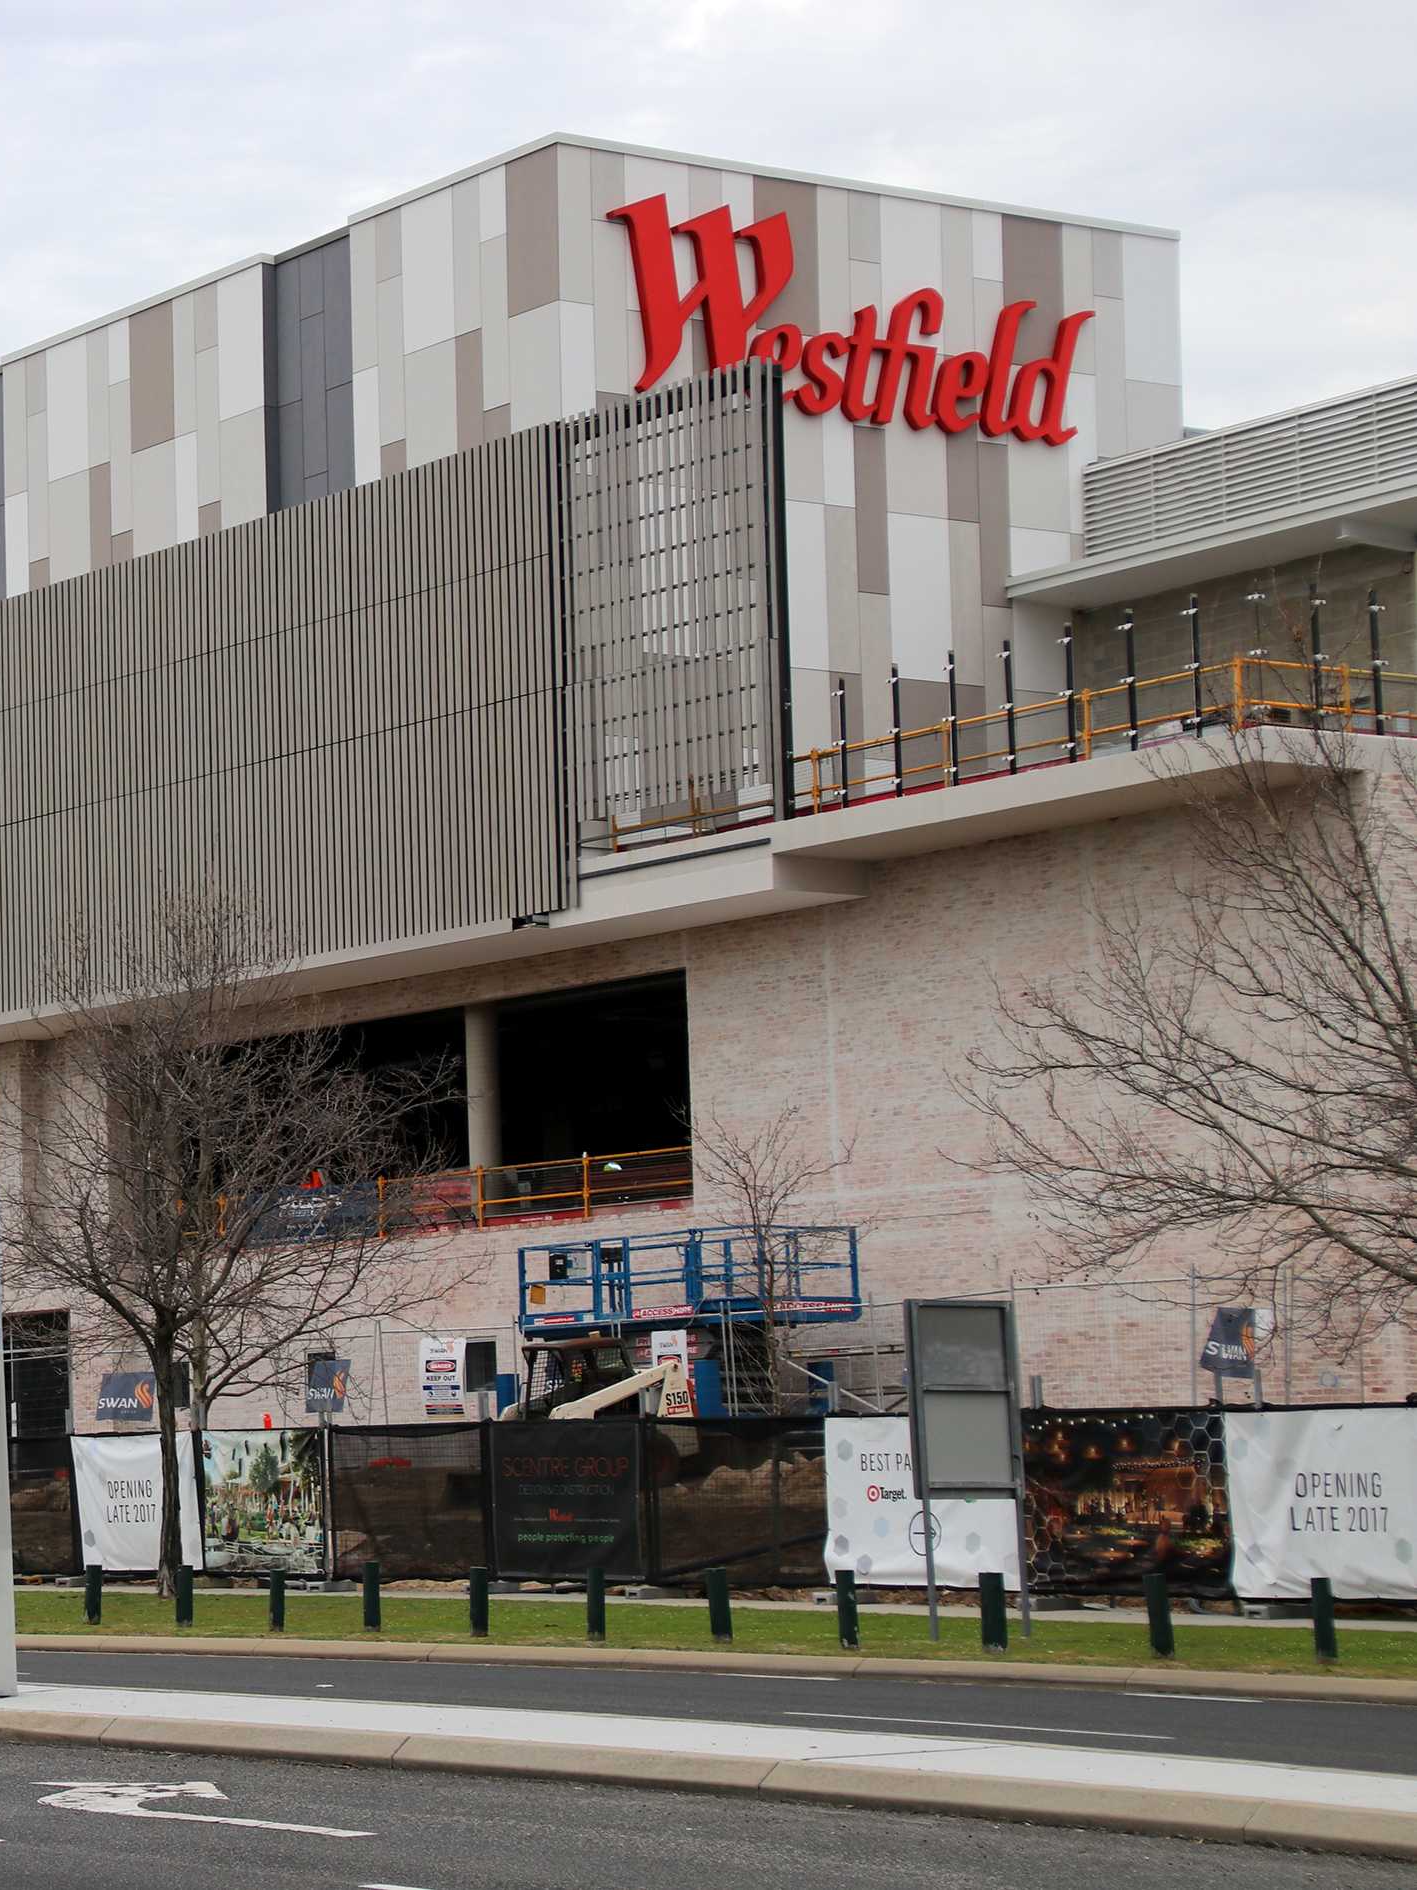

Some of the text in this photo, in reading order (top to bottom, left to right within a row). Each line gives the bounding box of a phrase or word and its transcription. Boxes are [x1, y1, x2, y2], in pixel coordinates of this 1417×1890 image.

[605, 192, 1096, 447] Westfield
[98, 1397, 138, 1409] SWAN
[665, 1391, 689, 1406] S150
[860, 1453, 912, 1472] BEST PA
[107, 1479, 152, 1499] OPENING
[1295, 1472, 1382, 1498] OPENING
[106, 1504, 156, 1523] LATE 2017
[1290, 1506, 1388, 1532] LATE 2017
